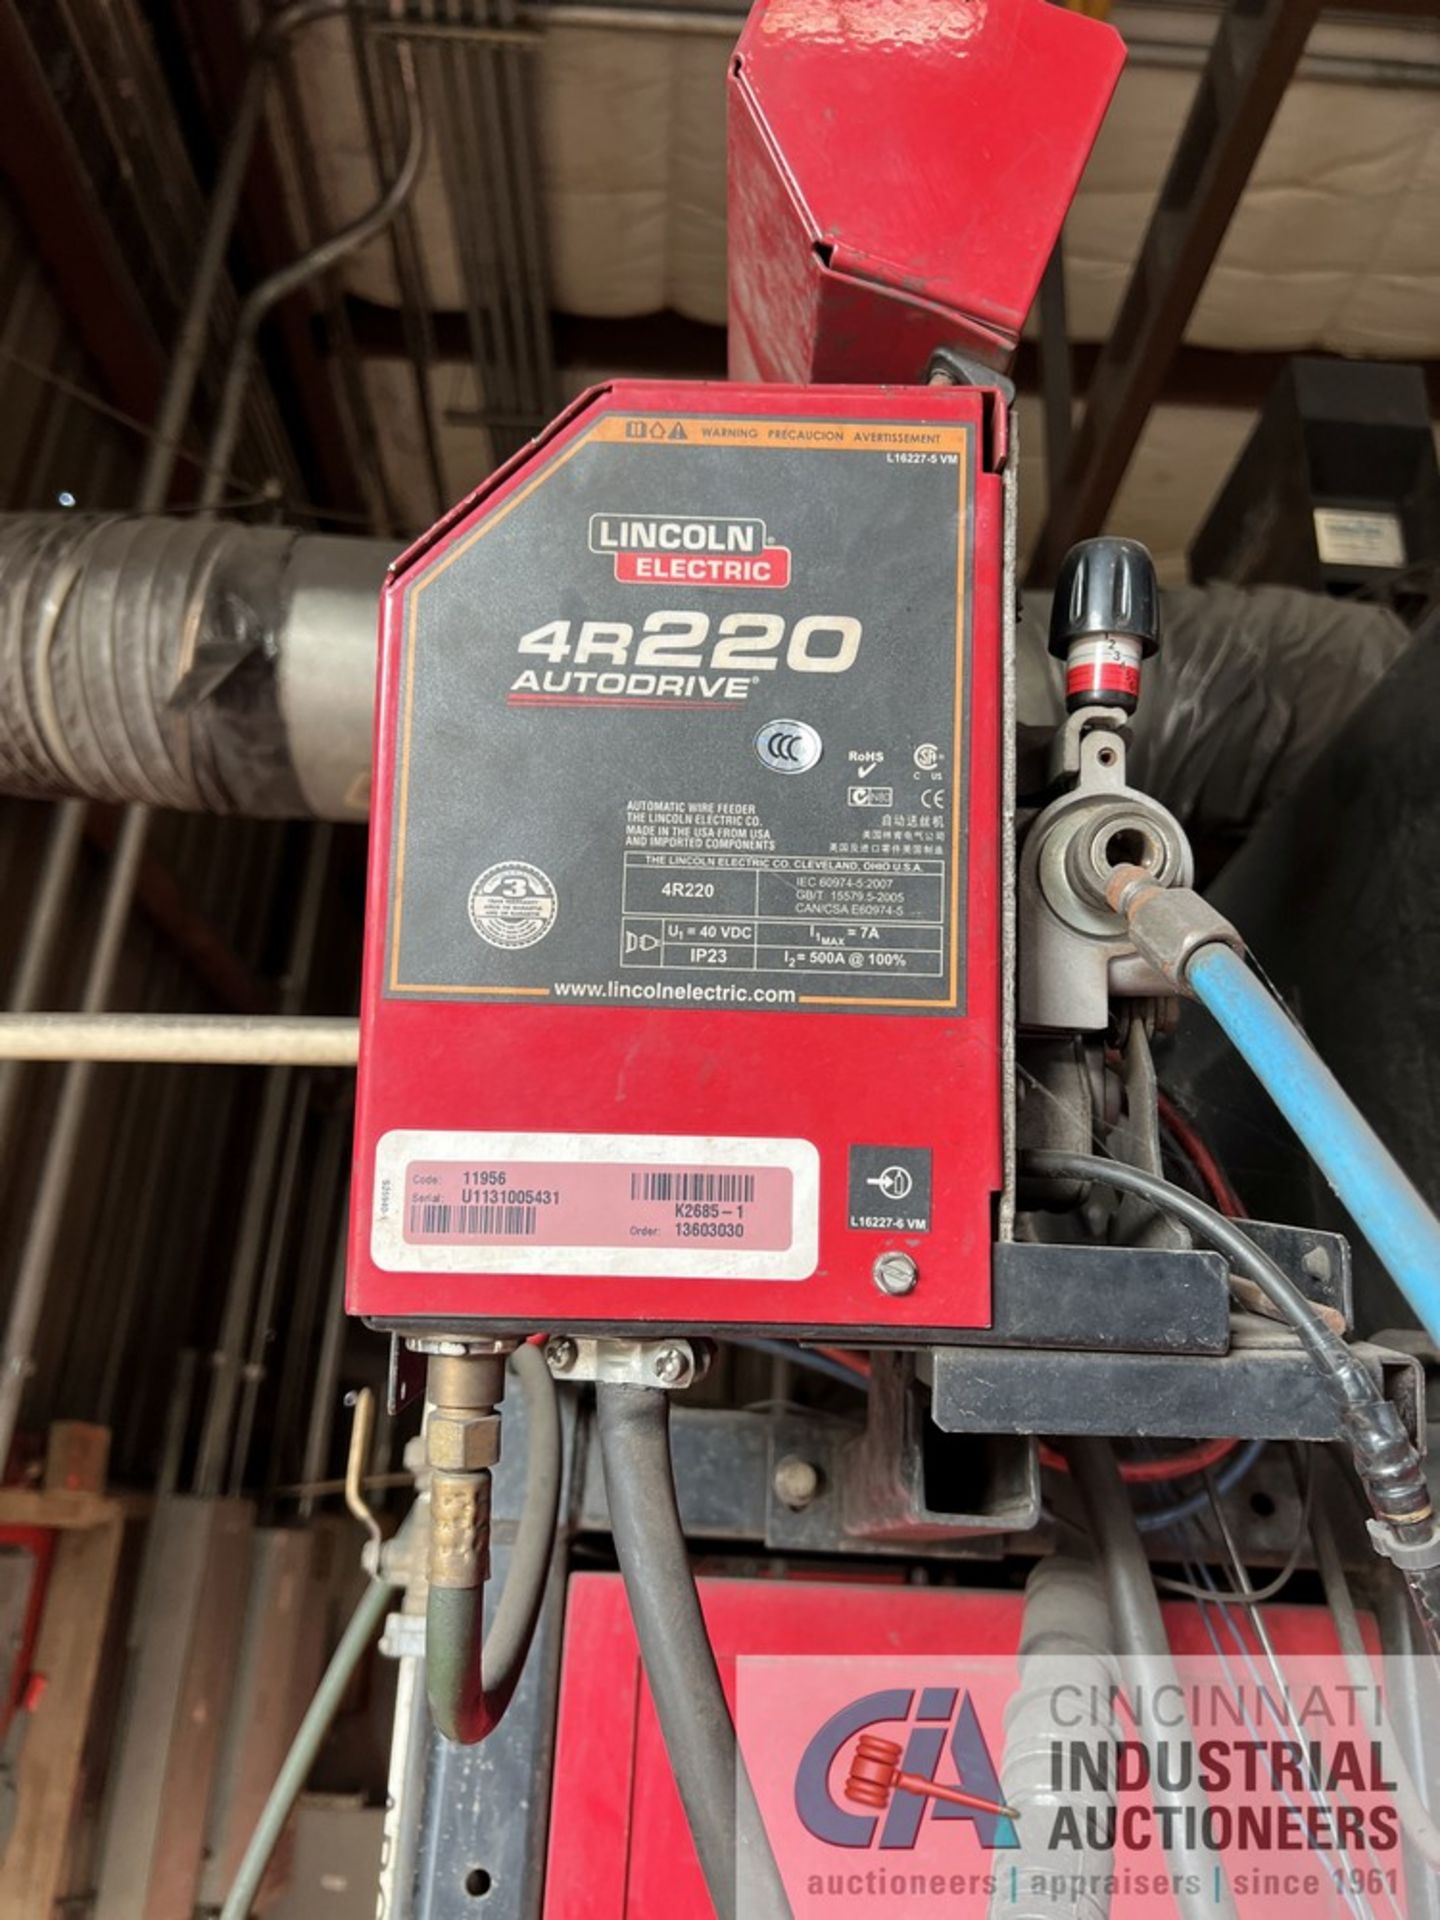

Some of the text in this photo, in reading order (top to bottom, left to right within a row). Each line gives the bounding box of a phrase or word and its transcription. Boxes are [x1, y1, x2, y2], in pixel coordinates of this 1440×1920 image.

[701, 427, 941, 445] WARNING PRECAUCION AVERTISSEMENT
[886, 453, 958, 465] L16227-5 VM
[600, 520, 755, 552] LINCOLN
[636, 557, 772, 582] ELECTRIC
[517, 610, 863, 673] 4R220
[1108, 639, 1116, 650] 2
[1113, 650, 1121, 661] 3
[848, 751, 885, 763] RoHS
[627, 800, 756, 815] AUTOMATIC WIRE FEEDER
[627, 812, 763, 827] THE LINCOLN ELECTRIC CO.
[625, 825, 771, 840] MADE IN THE USA FROM USA
[625, 836, 776, 851] AND IMPORTED COMPONENTS
[646, 855, 666, 865] THE
[669, 856, 715, 867] LINCOLN
[717, 857, 770, 868] ELECTRIC
[863, 862, 890, 871] OHIO
[502, 878, 528, 898] 3
[796, 876, 817, 888] IEC
[661, 882, 715, 898] 4R220
[796, 890, 824, 901] GB/T
[795, 903, 904, 917] CAN/CSA E60974-5
[699, 925, 717, 938] 40
[720, 926, 752, 939] VDC
[860, 927, 880, 940] 7A
[690, 948, 728, 963] IP23
[810, 952, 846, 965] 500A
[848, 953, 865, 968] @
[868, 953, 907, 967] 100%
[553, 980, 797, 1003] www.lincolnelectric.com
[463, 1170, 507, 1186] 11956
[461, 1188, 560, 1205] U1131005431
[675, 1222, 745, 1238] 13603030
[850, 1216, 927, 1230] L16227-6 VM
